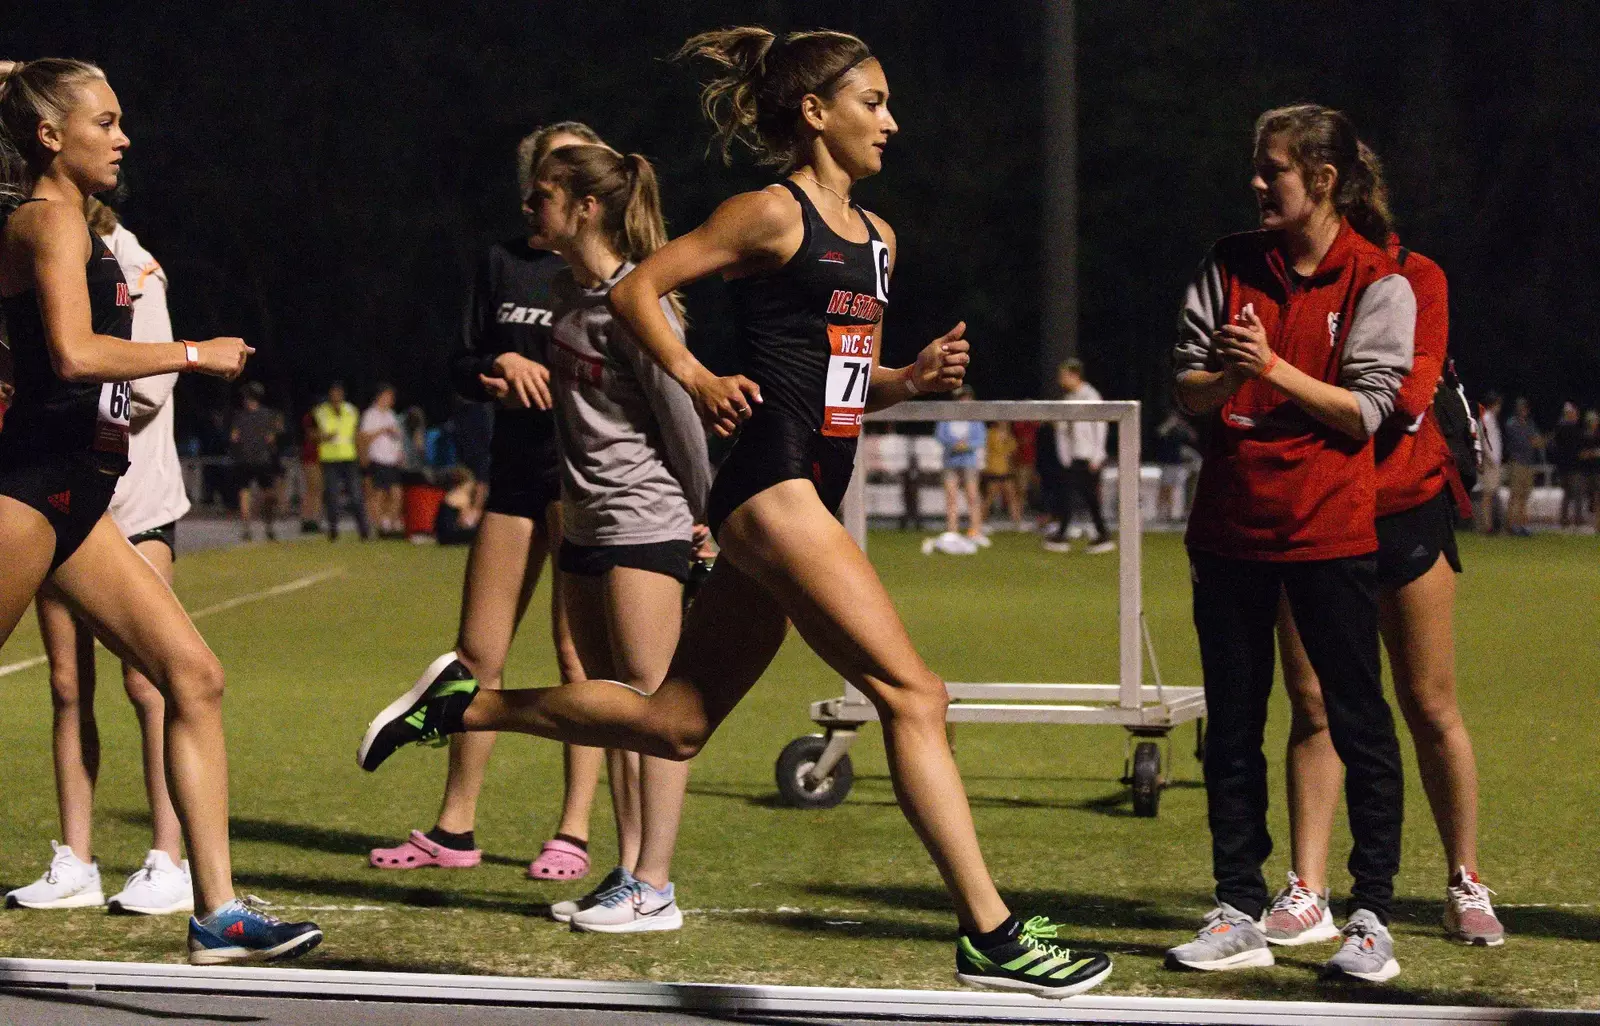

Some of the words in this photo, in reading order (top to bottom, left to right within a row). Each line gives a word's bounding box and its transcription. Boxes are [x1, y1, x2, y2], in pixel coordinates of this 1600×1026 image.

[827, 289, 853, 315] NC
[841, 335, 861, 354] NC
[842, 362, 869, 403] 71
